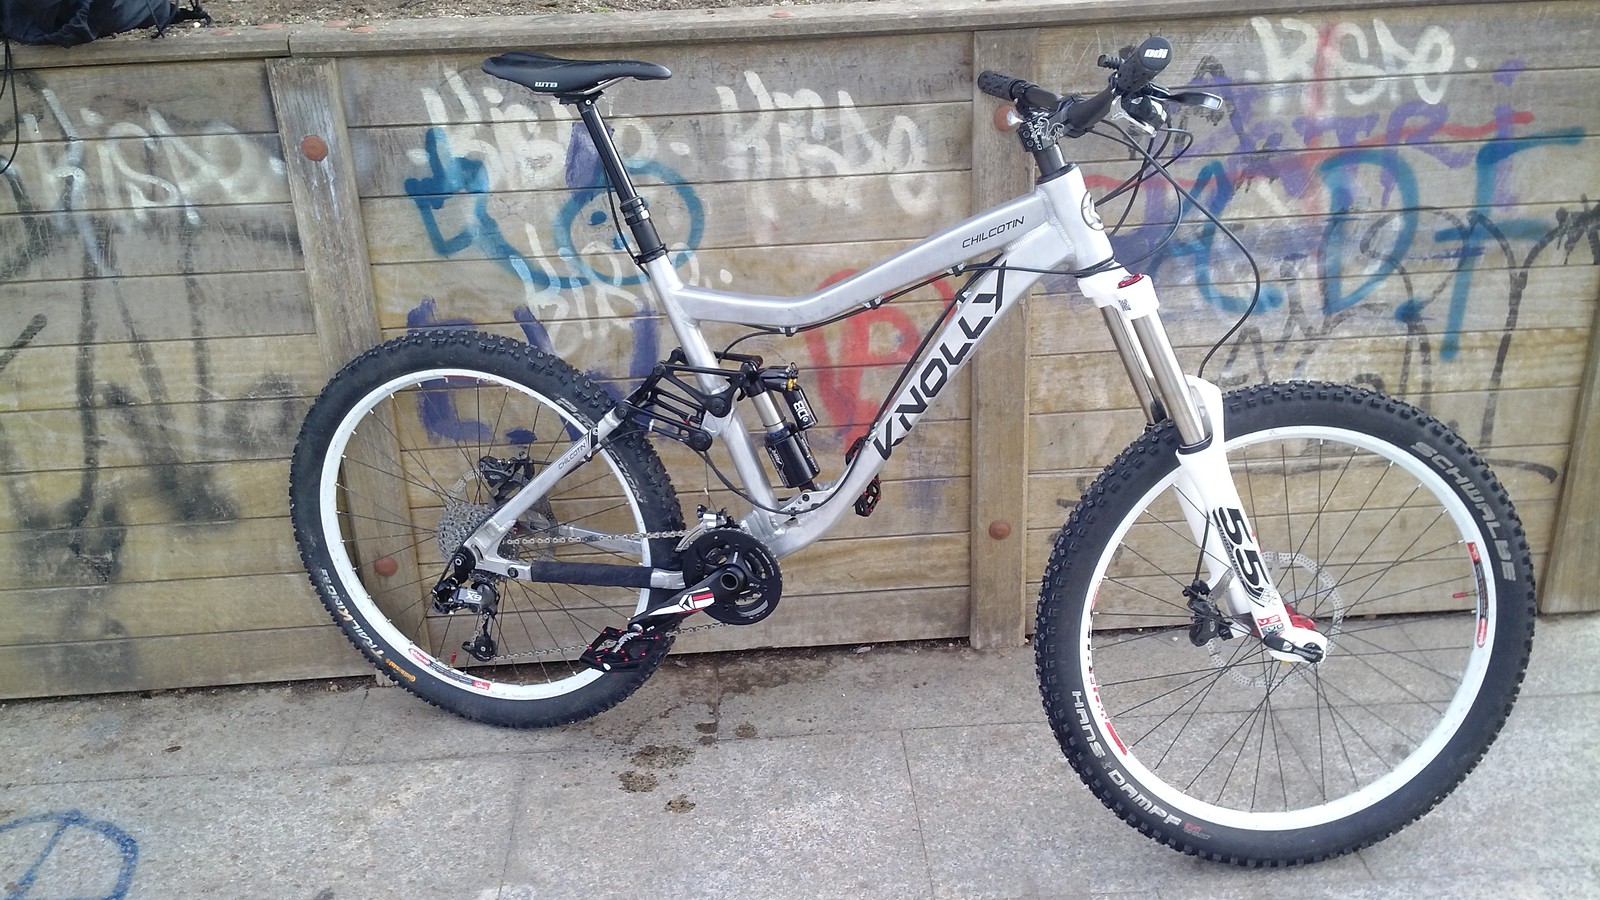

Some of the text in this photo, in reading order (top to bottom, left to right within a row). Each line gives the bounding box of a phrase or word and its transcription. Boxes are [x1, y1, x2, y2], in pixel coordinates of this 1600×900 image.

[534, 81, 558, 89] WTB
[961, 215, 1025, 249] CHILCOTIN
[872, 258, 1008, 461] KNOLLY
[558, 440, 587, 470] CHILCOTIN
[1410, 441, 1517, 582] SCHWALBE
[1217, 506, 1271, 587] 55
[325, 583, 354, 623] KING
[352, 619, 385, 660] TRAIL
[1071, 690, 1183, 827] HANS DAMPF
